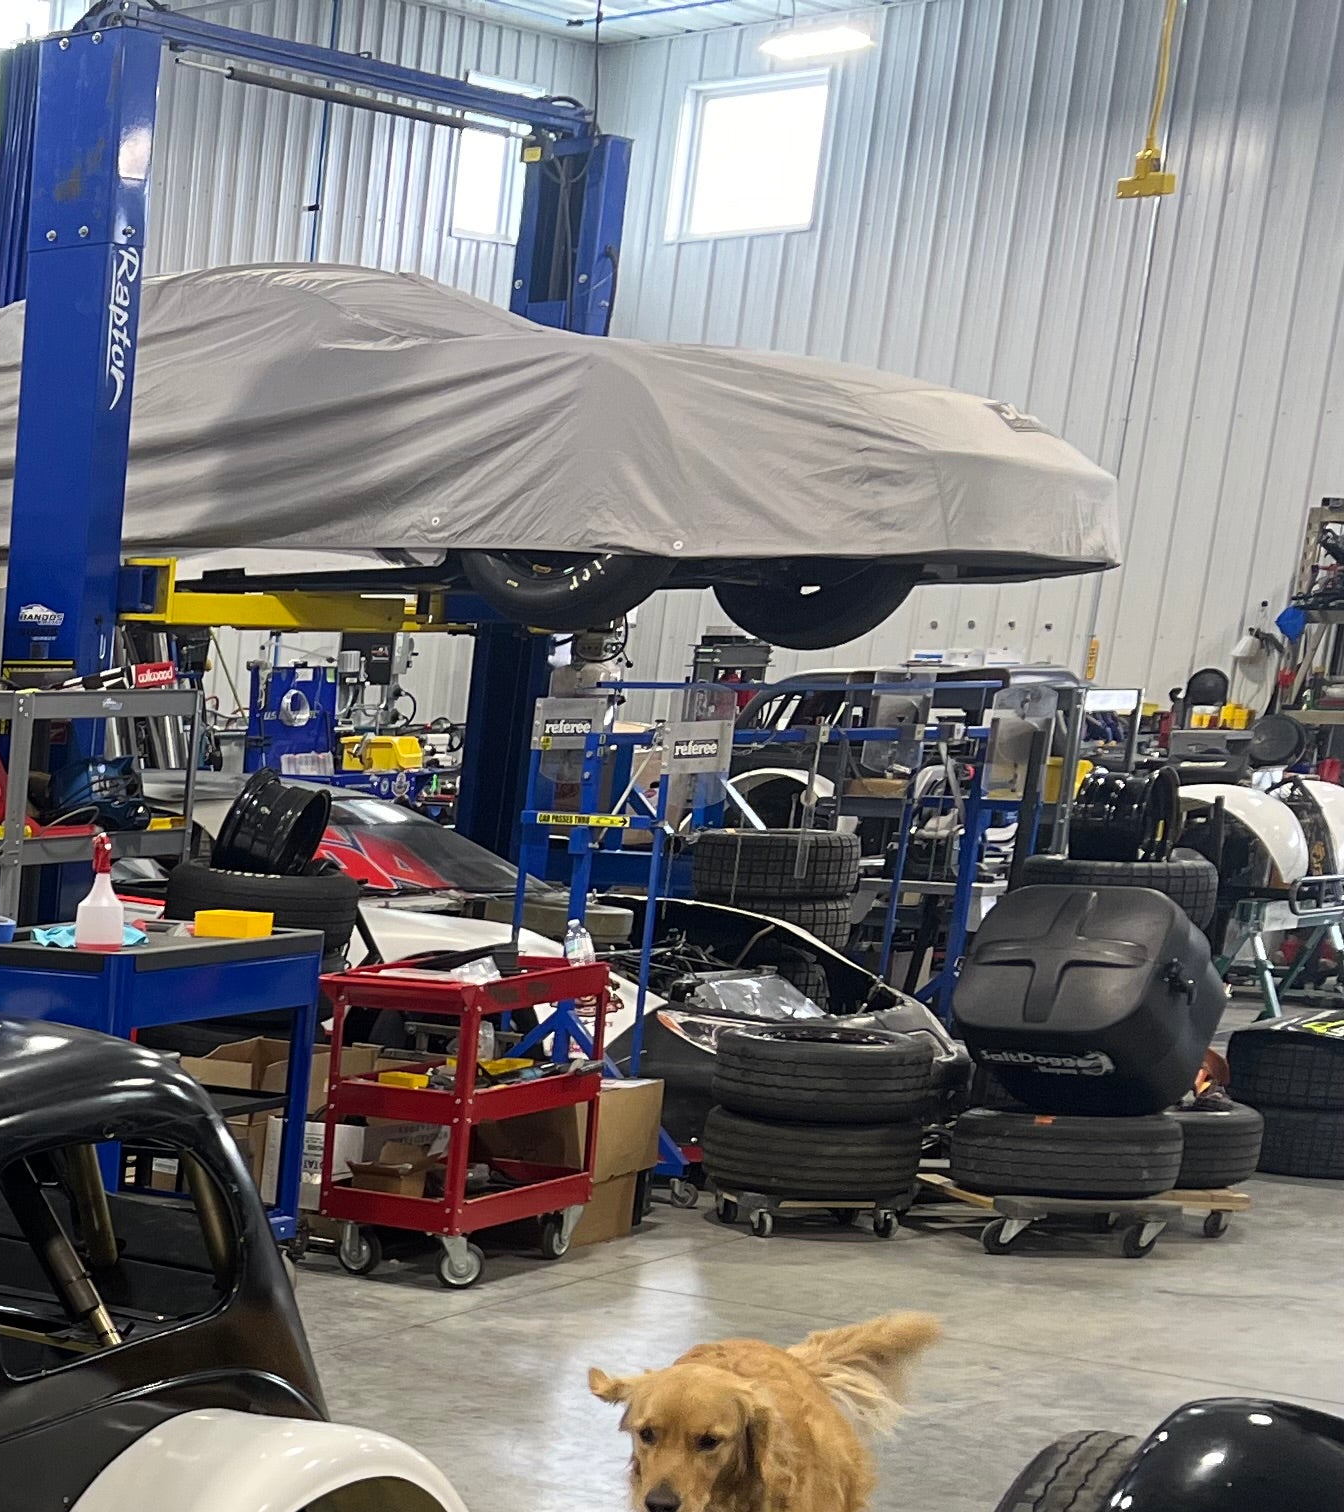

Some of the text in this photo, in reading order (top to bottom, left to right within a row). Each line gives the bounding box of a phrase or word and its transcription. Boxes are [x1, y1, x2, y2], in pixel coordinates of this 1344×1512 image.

[109, 247, 140, 410] Raptor
[544, 719, 591, 733] referee
[673, 740, 717, 756] referee
